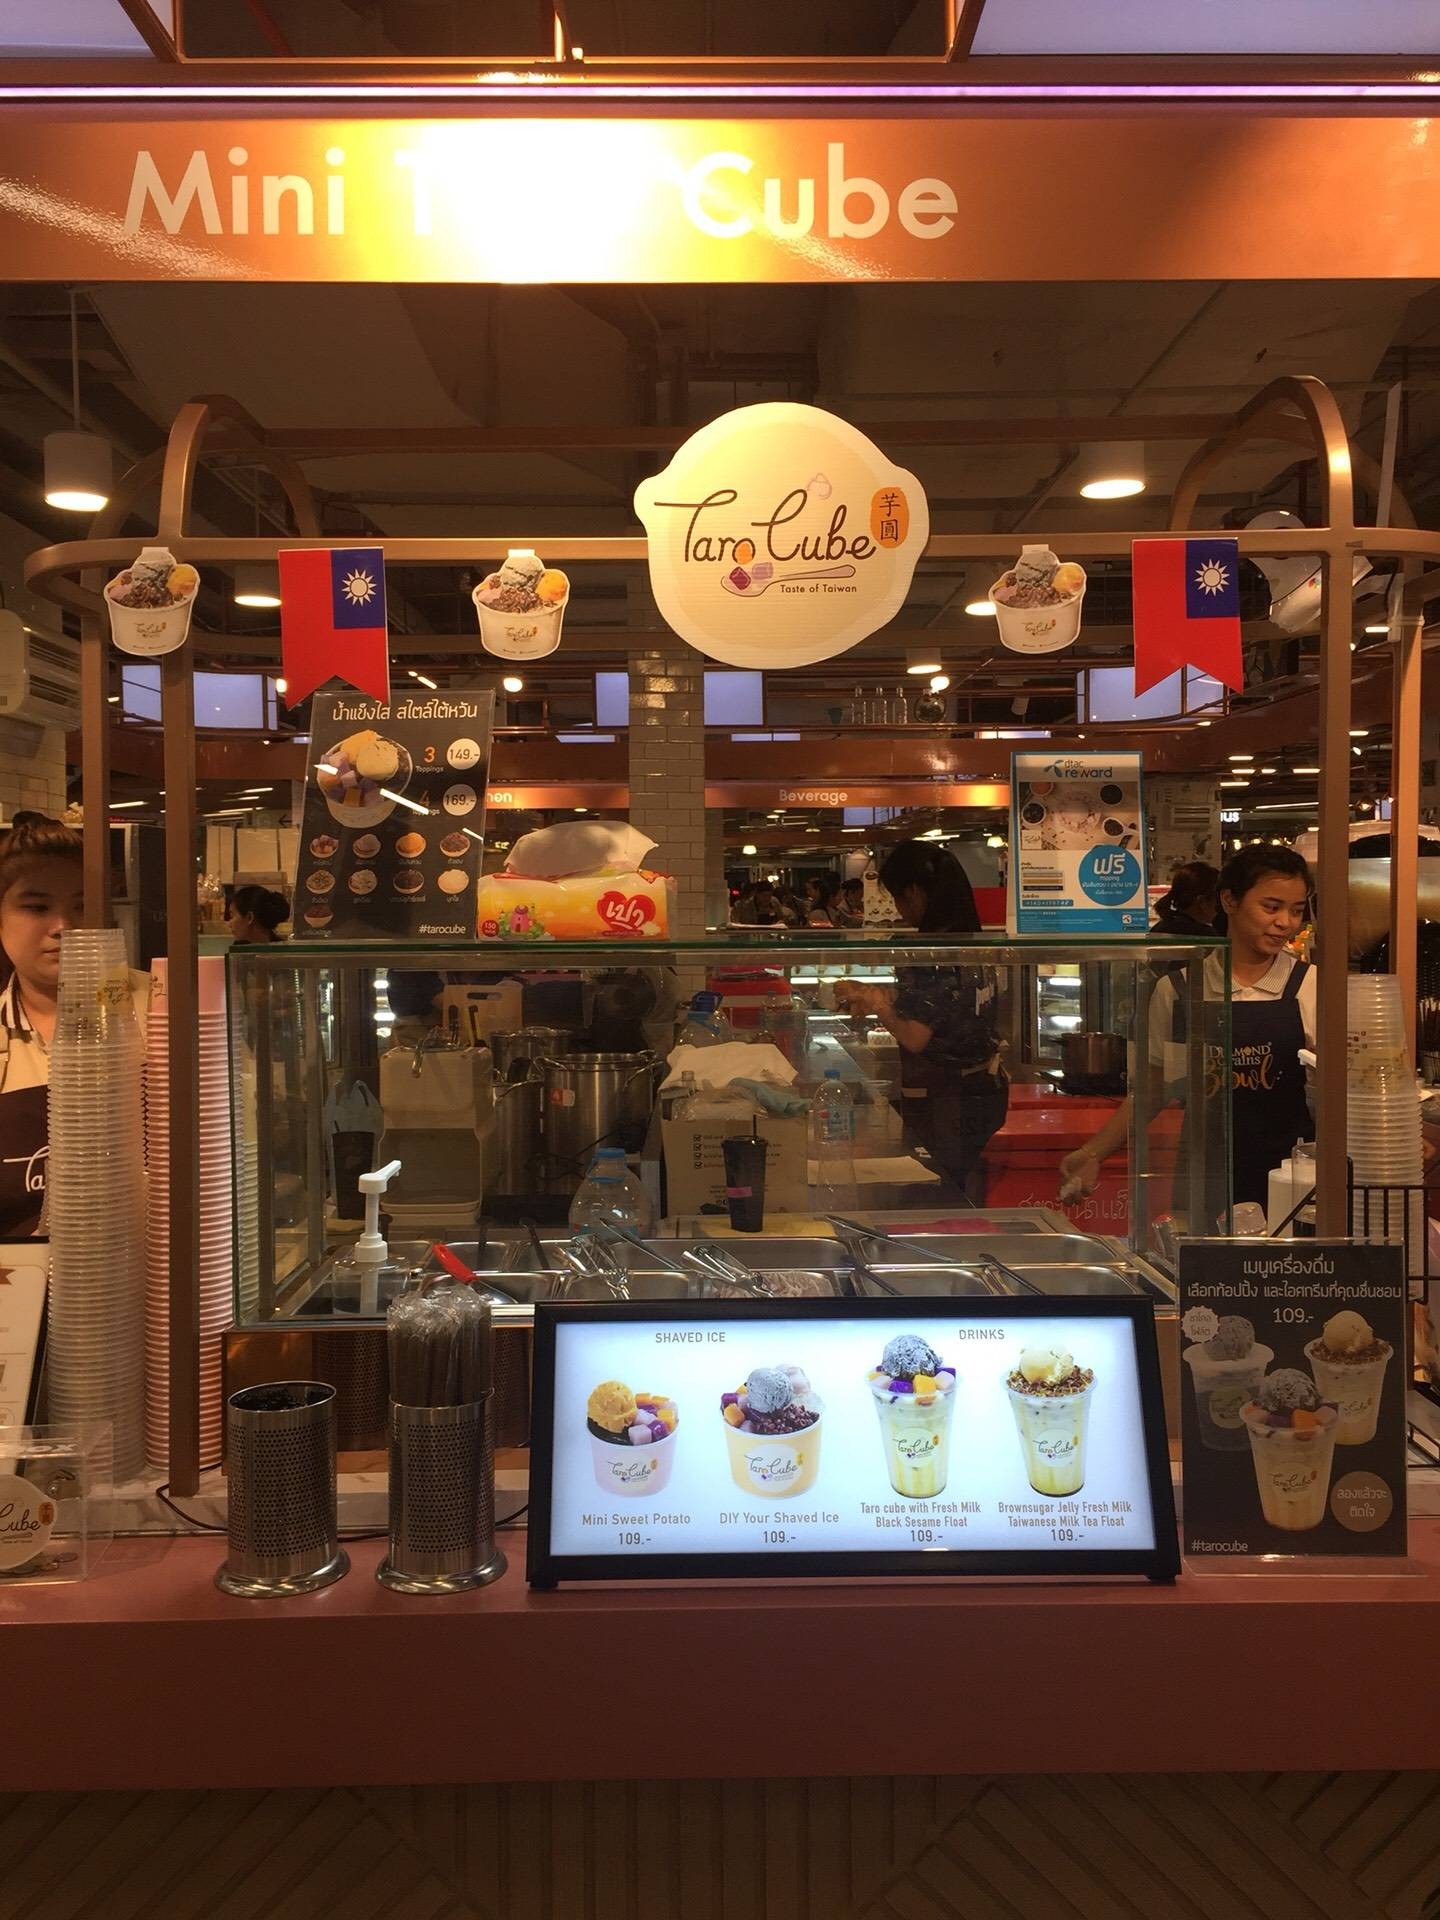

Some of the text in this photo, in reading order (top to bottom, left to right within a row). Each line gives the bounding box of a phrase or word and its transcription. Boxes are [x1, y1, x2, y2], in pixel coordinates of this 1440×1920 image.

[123, 147, 345, 237] Mini
[683, 142, 959, 239] Cube
[654, 489, 877, 566] Taro Cube
[780, 584, 857, 593] Taste of Taiwan
[424, 746, 436, 764] 3
[1064, 759, 1084, 769] dtac
[1065, 766, 1112, 778] reward
[779, 788, 848, 806] Beverage
[419, 923, 466, 935] #tarocube
[1243, 1253, 1334, 1279] เมนูเครื่องดื่ม
[1273, 1308, 1314, 1323] 109.-
[655, 1332, 726, 1343] SHAVED ICE
[959, 1329, 1005, 1340] DRINKS
[860, 1502, 981, 1514] Taro cube with Fresh Milk
[998, 1502, 1132, 1516] Brownsugar Jelly Fresh Milk
[582, 1513, 691, 1525] Mini Sweet Potato
[719, 1511, 839, 1524] DIY Your Shaved Ice
[876, 1516, 968, 1527] Black Sesame Float
[1008, 1516, 1125, 1527] Taiwanese Milk Tea Float
[618, 1532, 652, 1545] 109.-
[763, 1531, 796, 1544] 109.-
[910, 1529, 944, 1542] 109.-
[1050, 1529, 1084, 1542] 109.-
[1191, 1539, 1249, 1553] #tarocube
